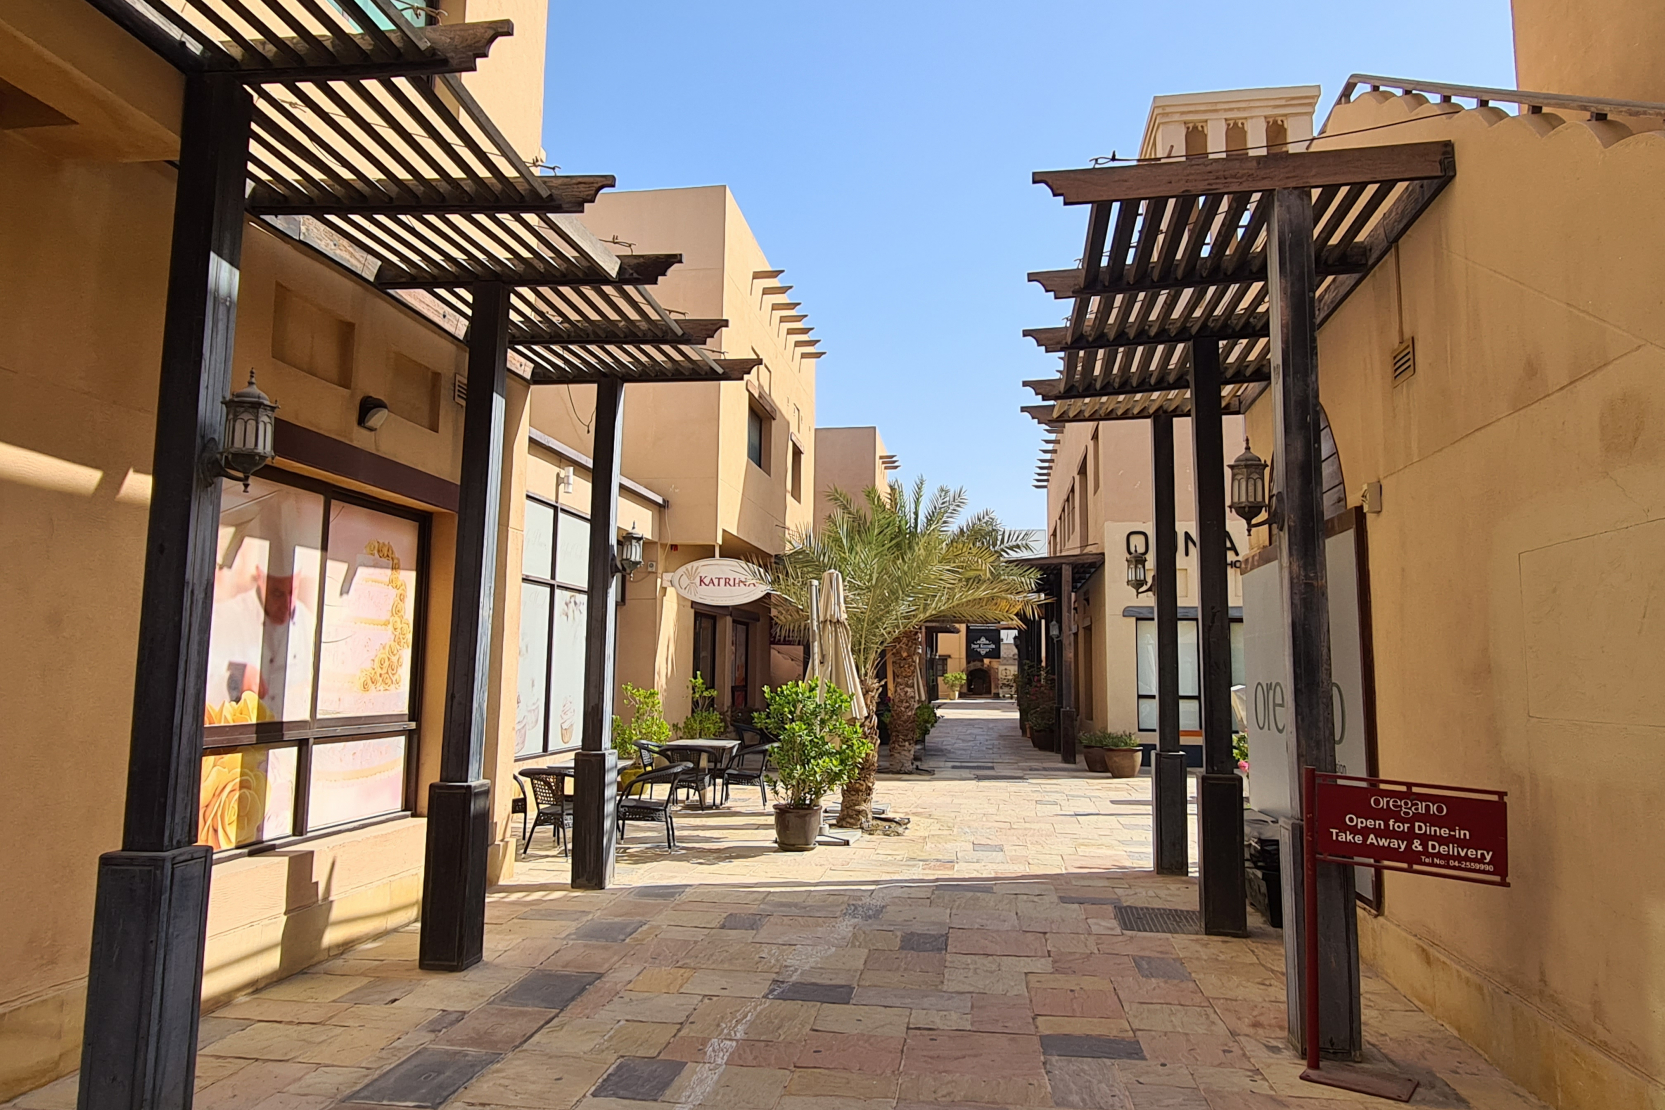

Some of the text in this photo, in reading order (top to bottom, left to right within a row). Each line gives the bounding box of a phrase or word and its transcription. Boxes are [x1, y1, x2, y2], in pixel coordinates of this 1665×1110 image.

[1370, 796, 1447, 818] oregano
[1345, 814, 1470, 840] Open for Dine-in
[1329, 828, 1493, 862] Take Away & Delivery
[1421, 856, 1432, 864] Tel
[1434, 857, 1447, 866] No:
